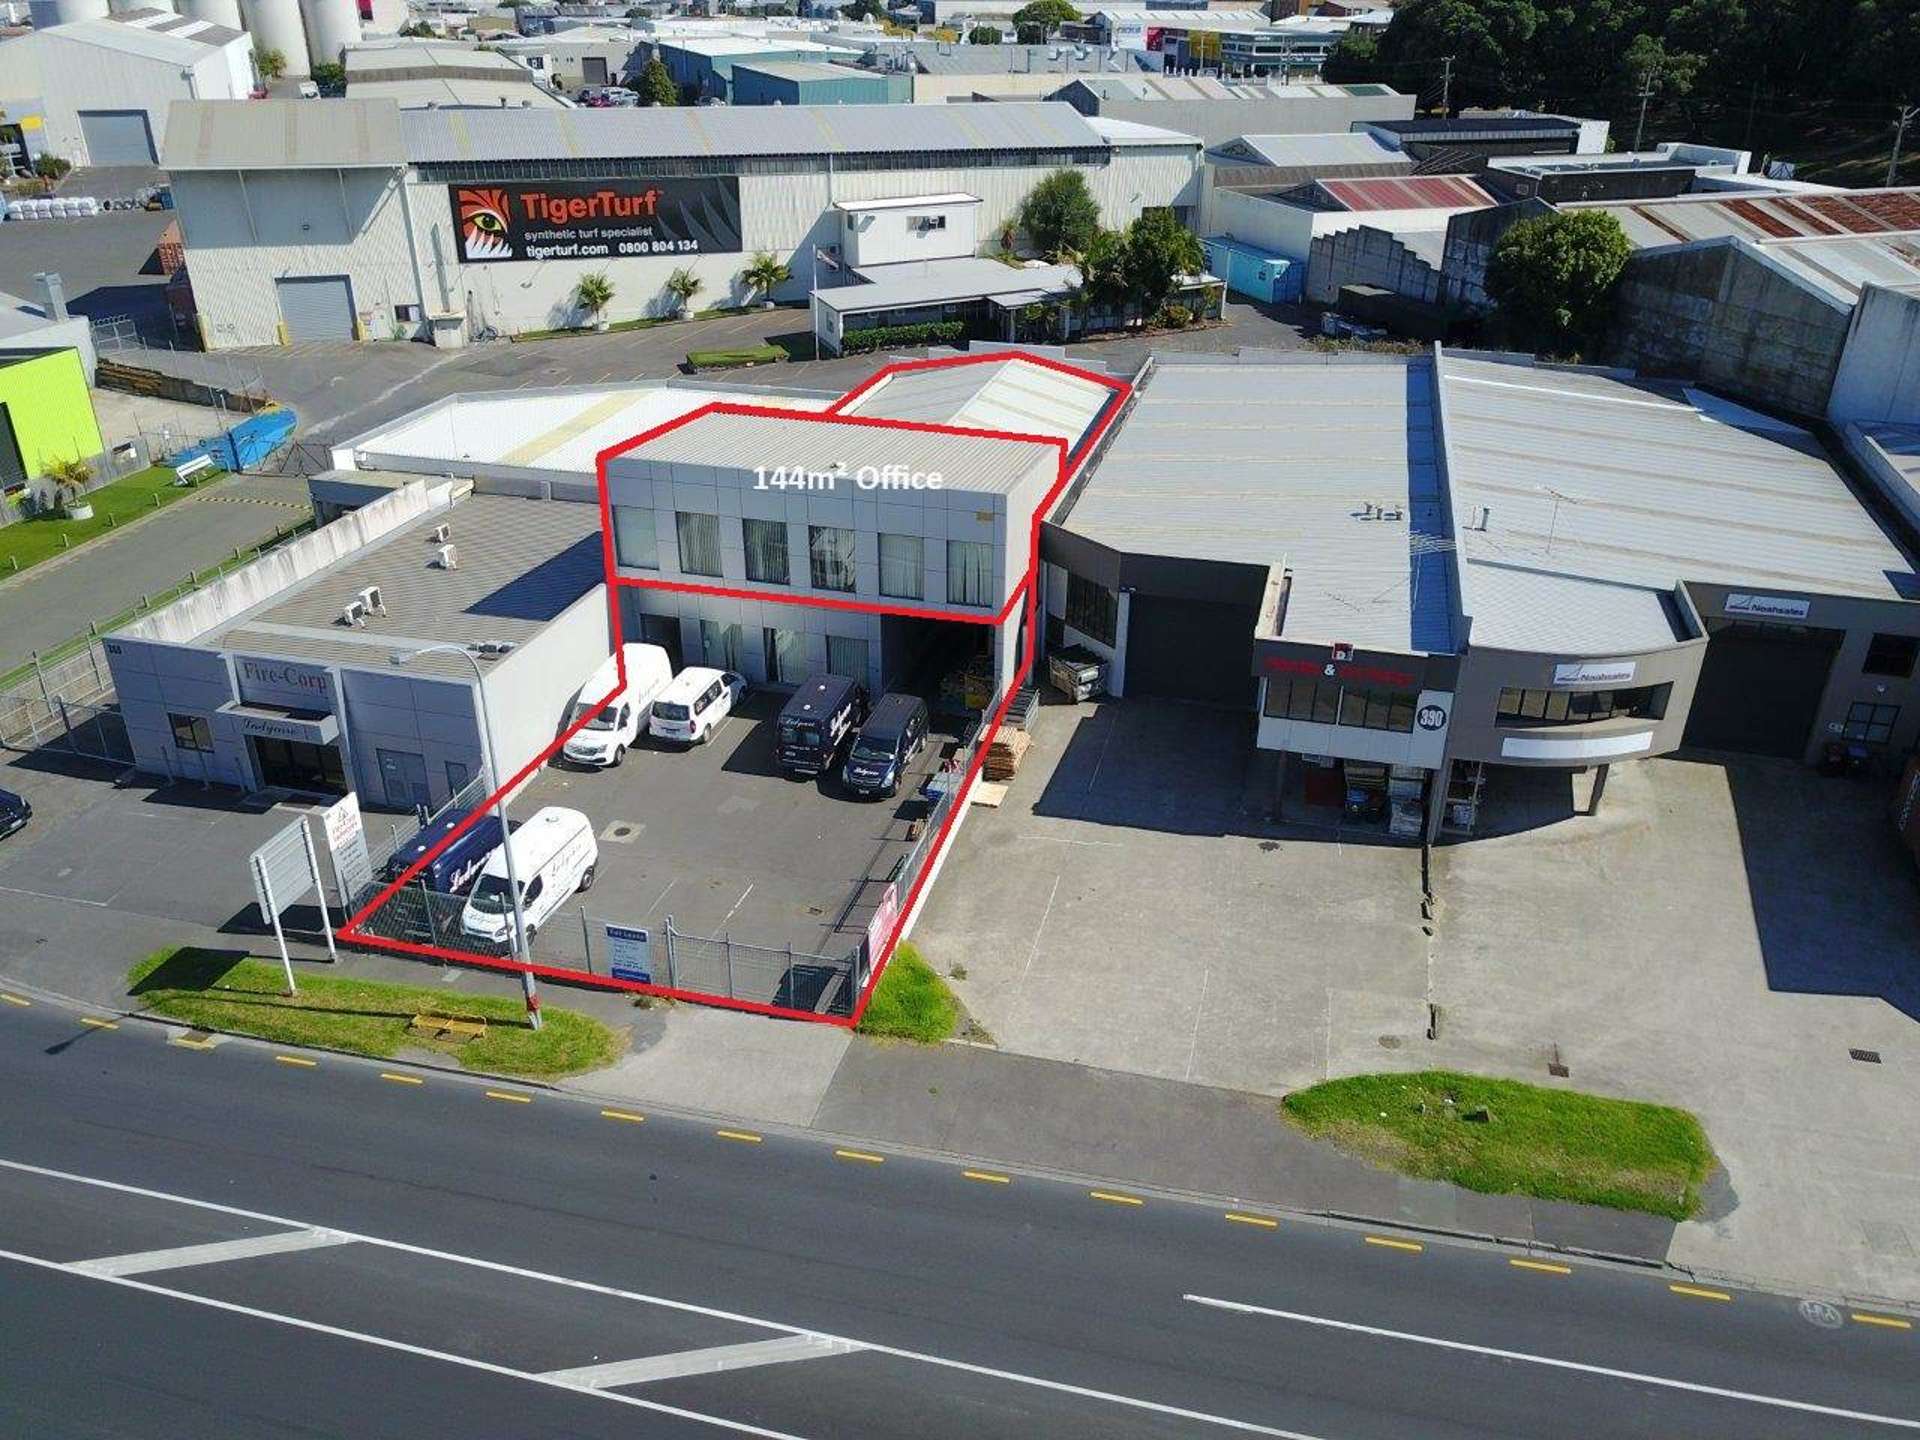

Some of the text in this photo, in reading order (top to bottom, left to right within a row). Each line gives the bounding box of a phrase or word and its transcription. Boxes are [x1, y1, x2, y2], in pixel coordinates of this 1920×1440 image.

[520, 190, 657, 225] TigerTurf
[524, 226, 653, 241] synthetic turf specialist
[526, 239, 698, 260] tigerturf.com 0800 804 134
[244, 662, 327, 693] Fire-Corp
[1420, 709, 1443, 727] 390
